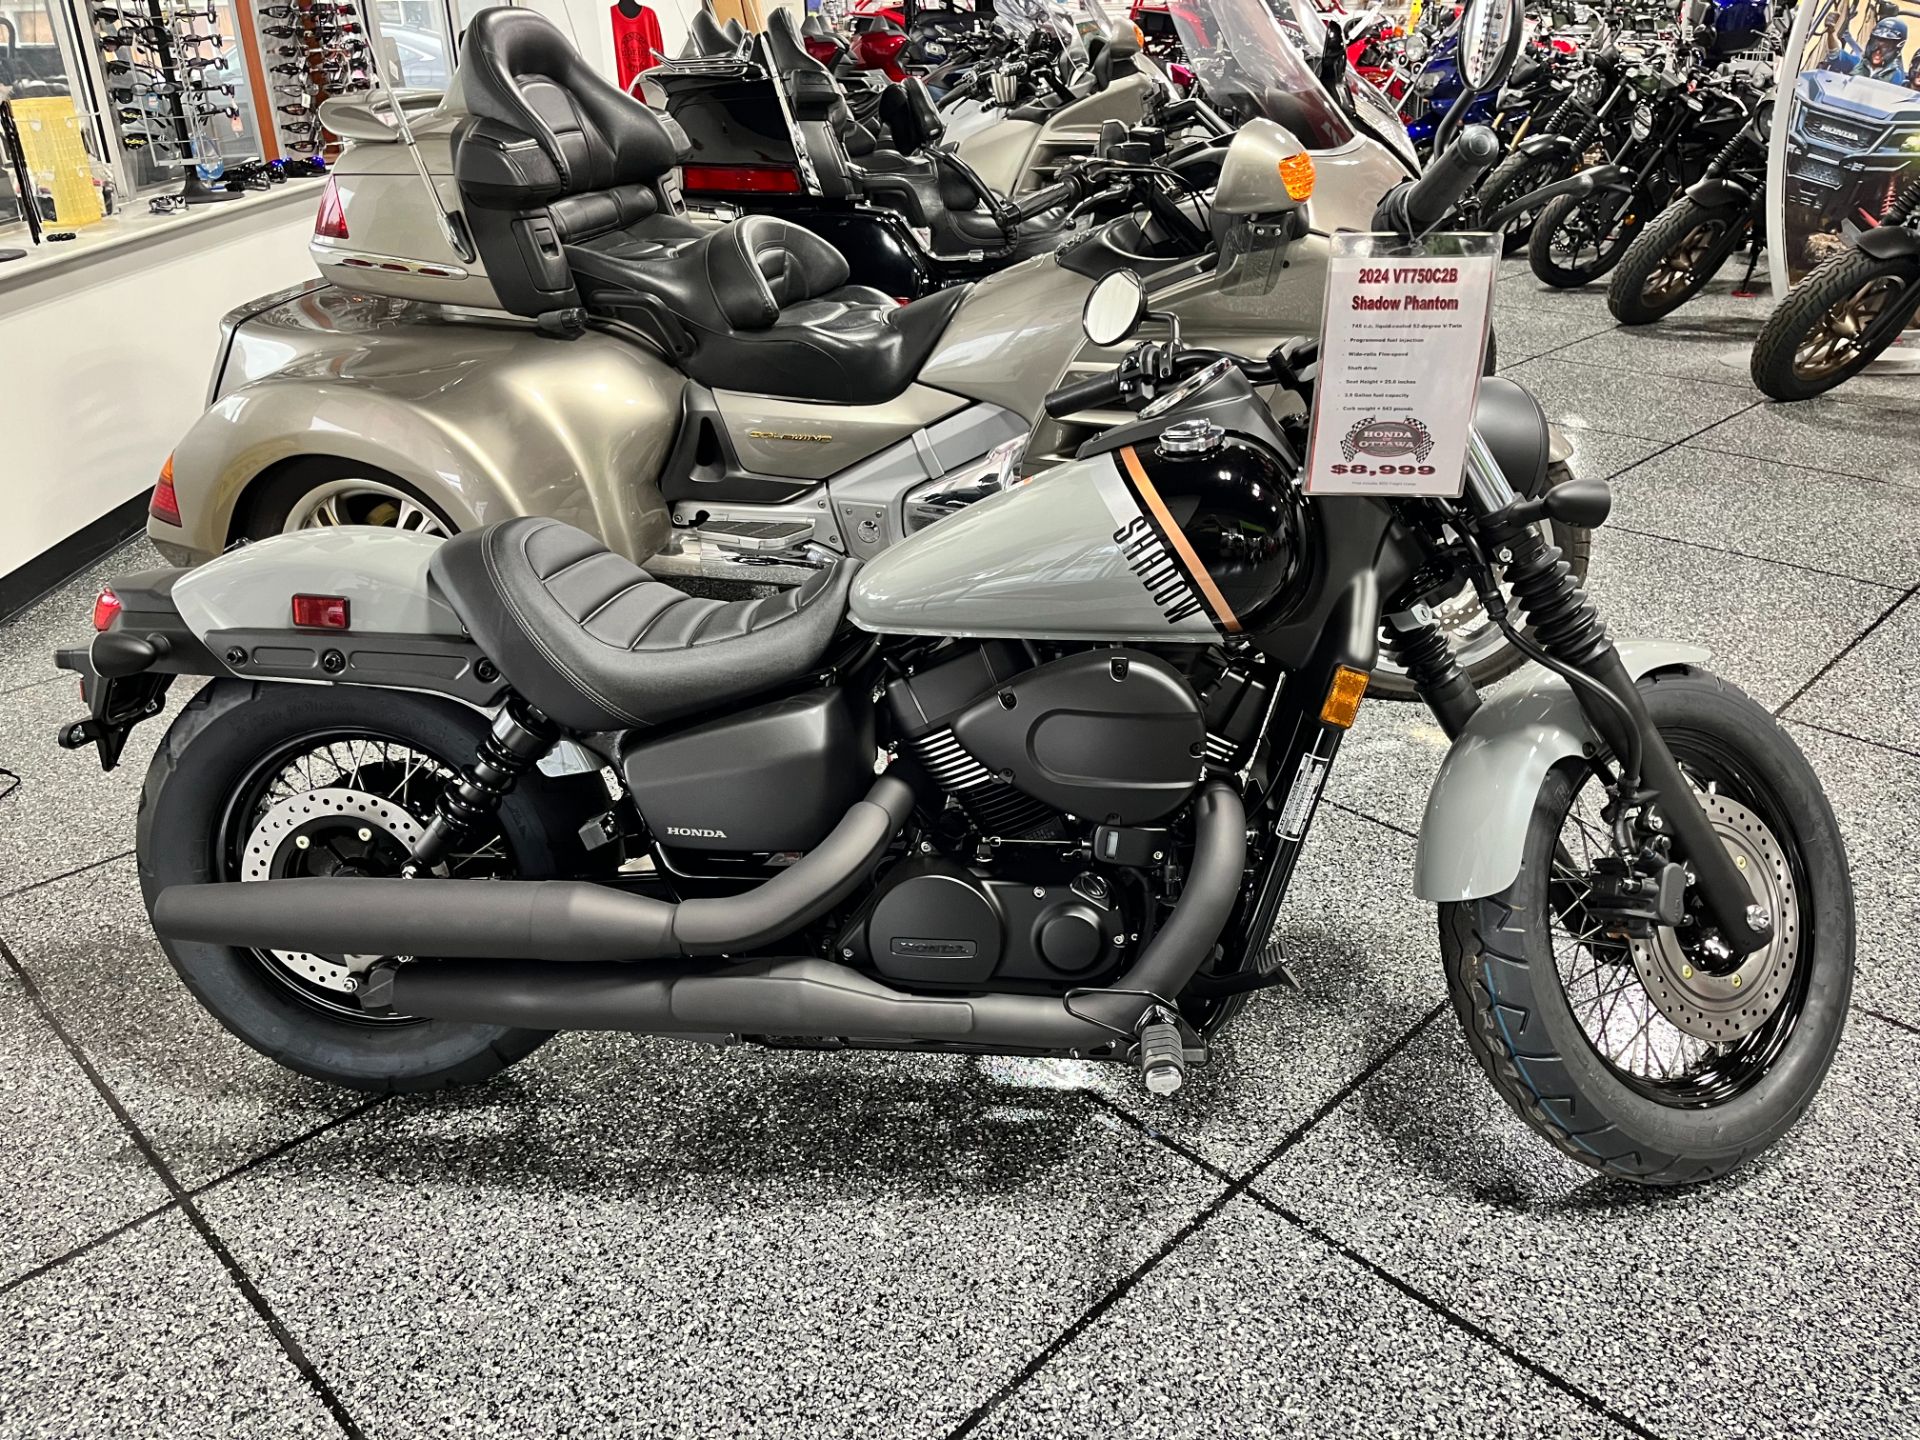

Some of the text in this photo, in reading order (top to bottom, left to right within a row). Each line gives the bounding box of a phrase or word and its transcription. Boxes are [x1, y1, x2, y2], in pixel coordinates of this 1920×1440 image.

[1819, 123, 1859, 141] HONDA
[1358, 267, 1458, 284] 2024 VT750C2B
[1351, 295, 1459, 311] Shadow Phantom
[1363, 430, 1413, 438] HONDA
[1330, 464, 1436, 476] $8,999
[1112, 515, 1202, 624] SHADOW
[667, 826, 727, 838] HONDA
